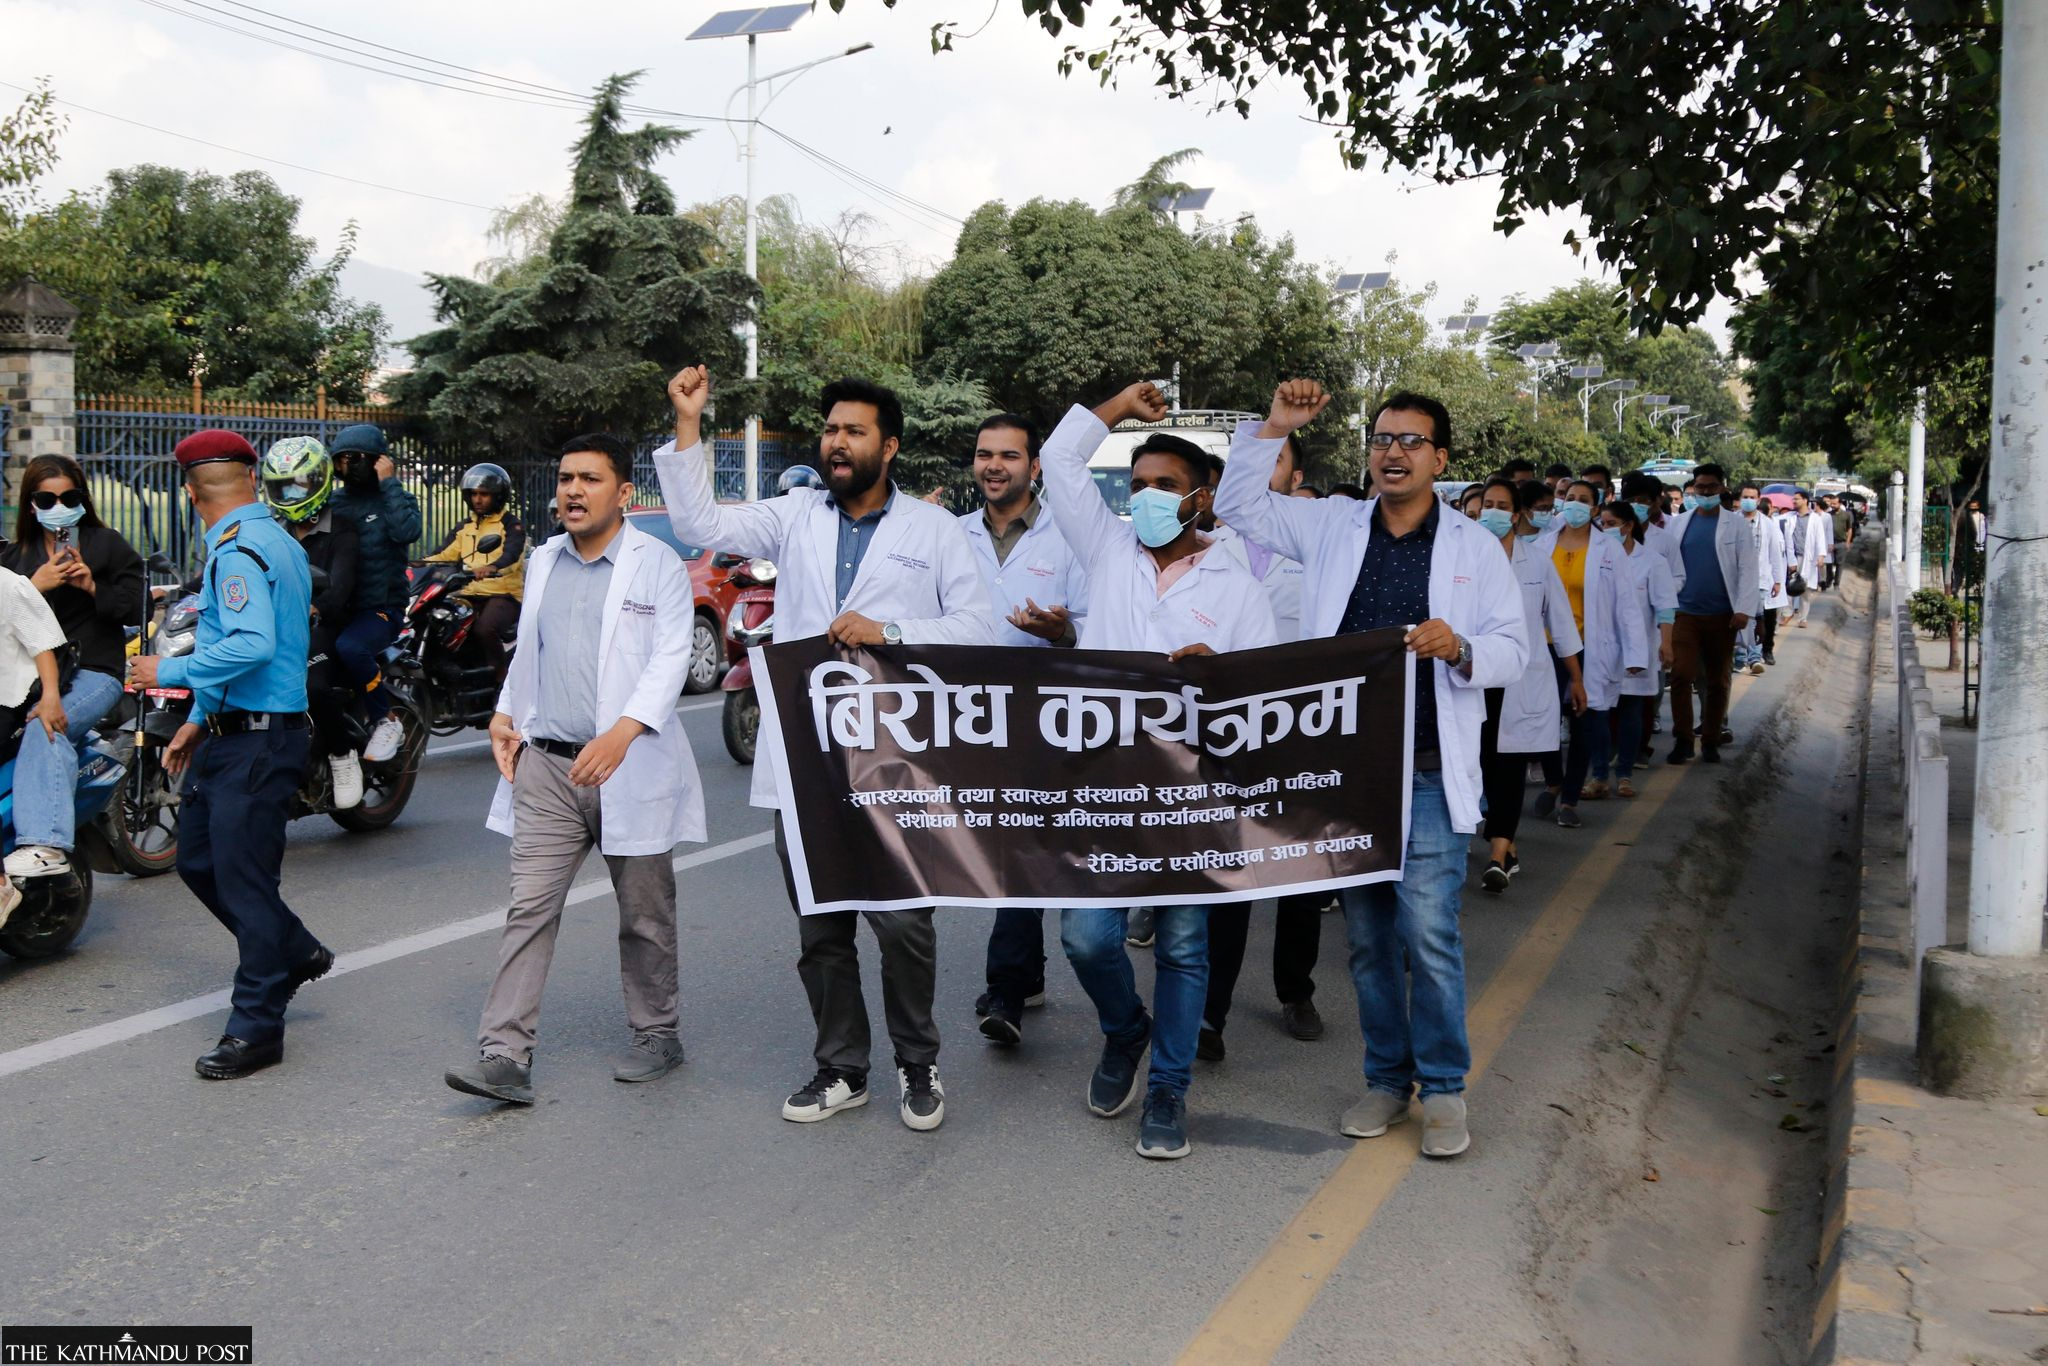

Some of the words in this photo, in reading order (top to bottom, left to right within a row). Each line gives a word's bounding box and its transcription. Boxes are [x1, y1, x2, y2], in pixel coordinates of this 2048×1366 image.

[808, 660, 1014, 753] बिरोध
[1038, 676, 1366, 757] कार्यक्रम
[849, 785, 952, 807] स्वास्थ्यकर्मी
[958, 788, 995, 804] तथा
[1001, 788, 1068, 804] स्वास्थ्य
[1073, 784, 1150, 804] संस्थाको
[1155, 783, 1209, 805] सुरक्षा
[1211, 777, 1280, 799] सम्बन्धी
[1285, 769, 1343, 790] पहिलो
[895, 809, 958, 828] संशोधन
[964, 809, 993, 828] ऐन
[998, 812, 1045, 828] २०७९
[1140, 806, 1237, 828] कार्यान्वयन
[1240, 802, 1270, 817] गर
[1088, 853, 1164, 873] रेजिडेन्ट
[1169, 849, 1265, 871] एसोसिएसन
[1271, 842, 1309, 860] अफ
[1314, 834, 1374, 854] न्याम्स
